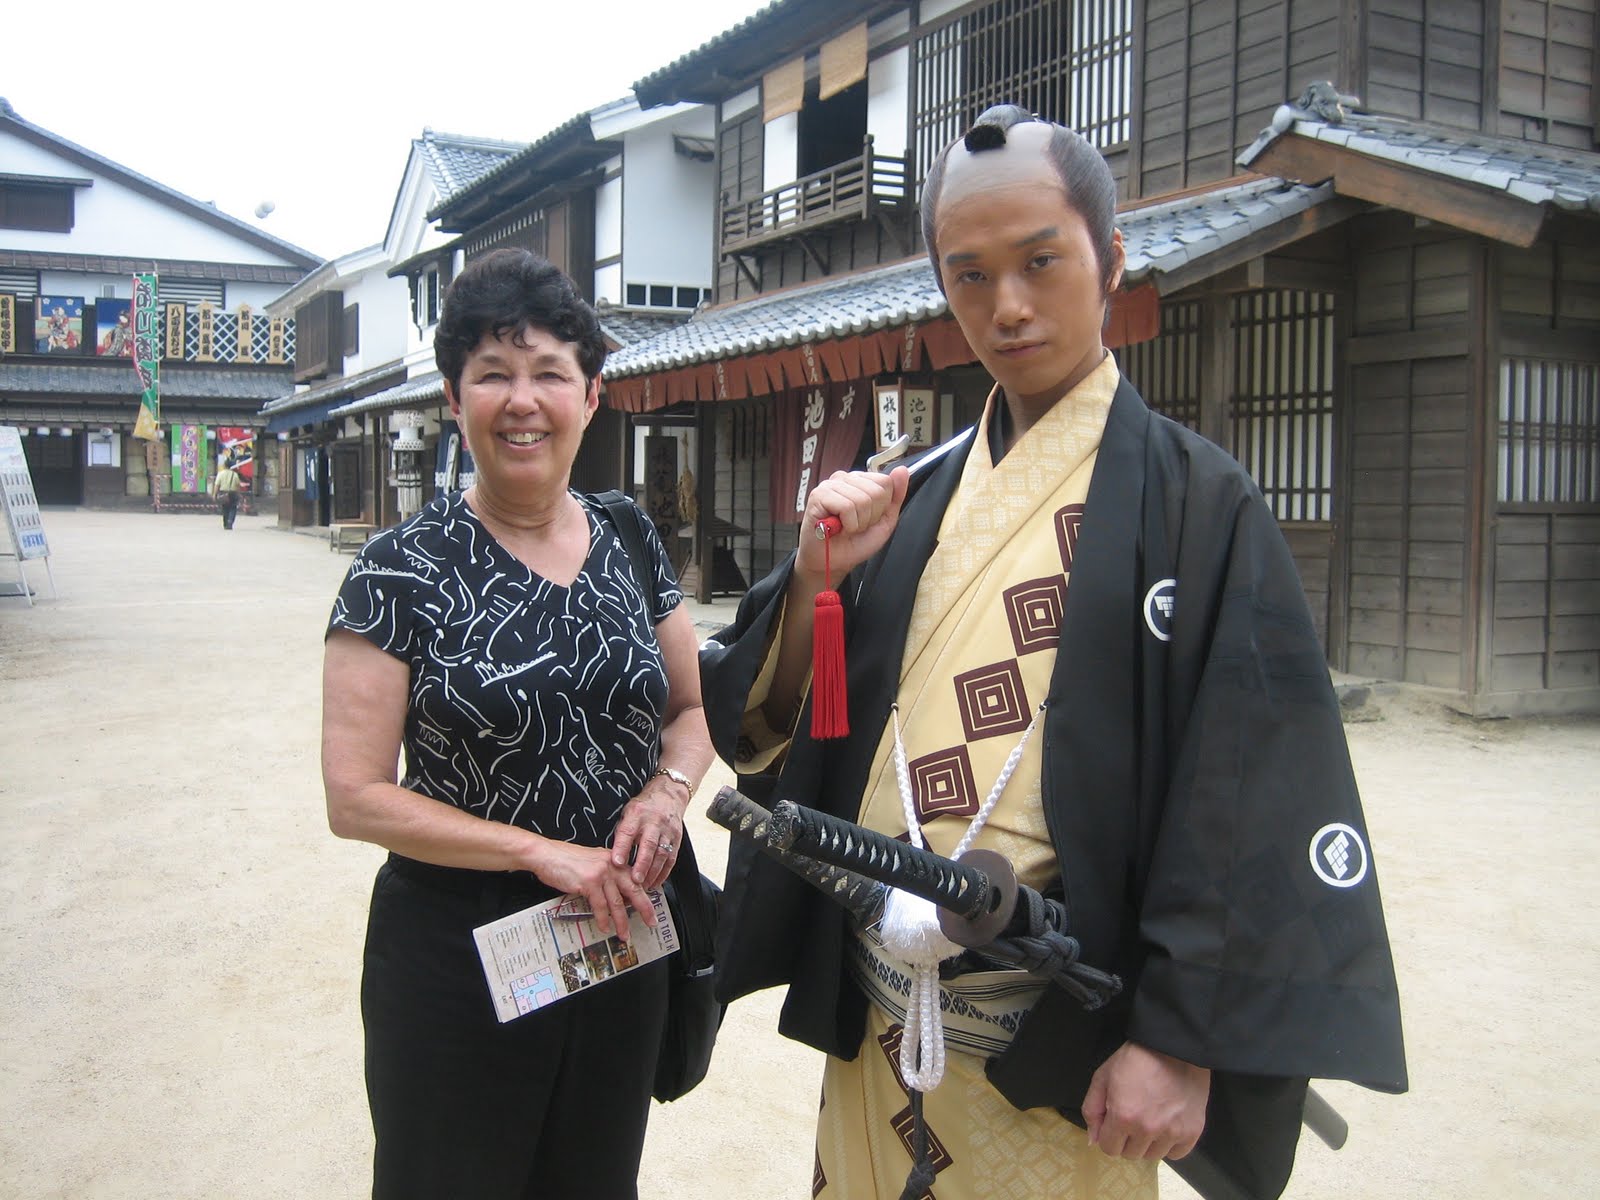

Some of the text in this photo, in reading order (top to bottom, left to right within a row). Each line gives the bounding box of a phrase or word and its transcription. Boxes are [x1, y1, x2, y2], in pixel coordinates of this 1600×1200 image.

[909, 397, 926, 443] 池田屋
[656, 911, 667, 923] TO
[660, 924, 673, 944] TOEI
